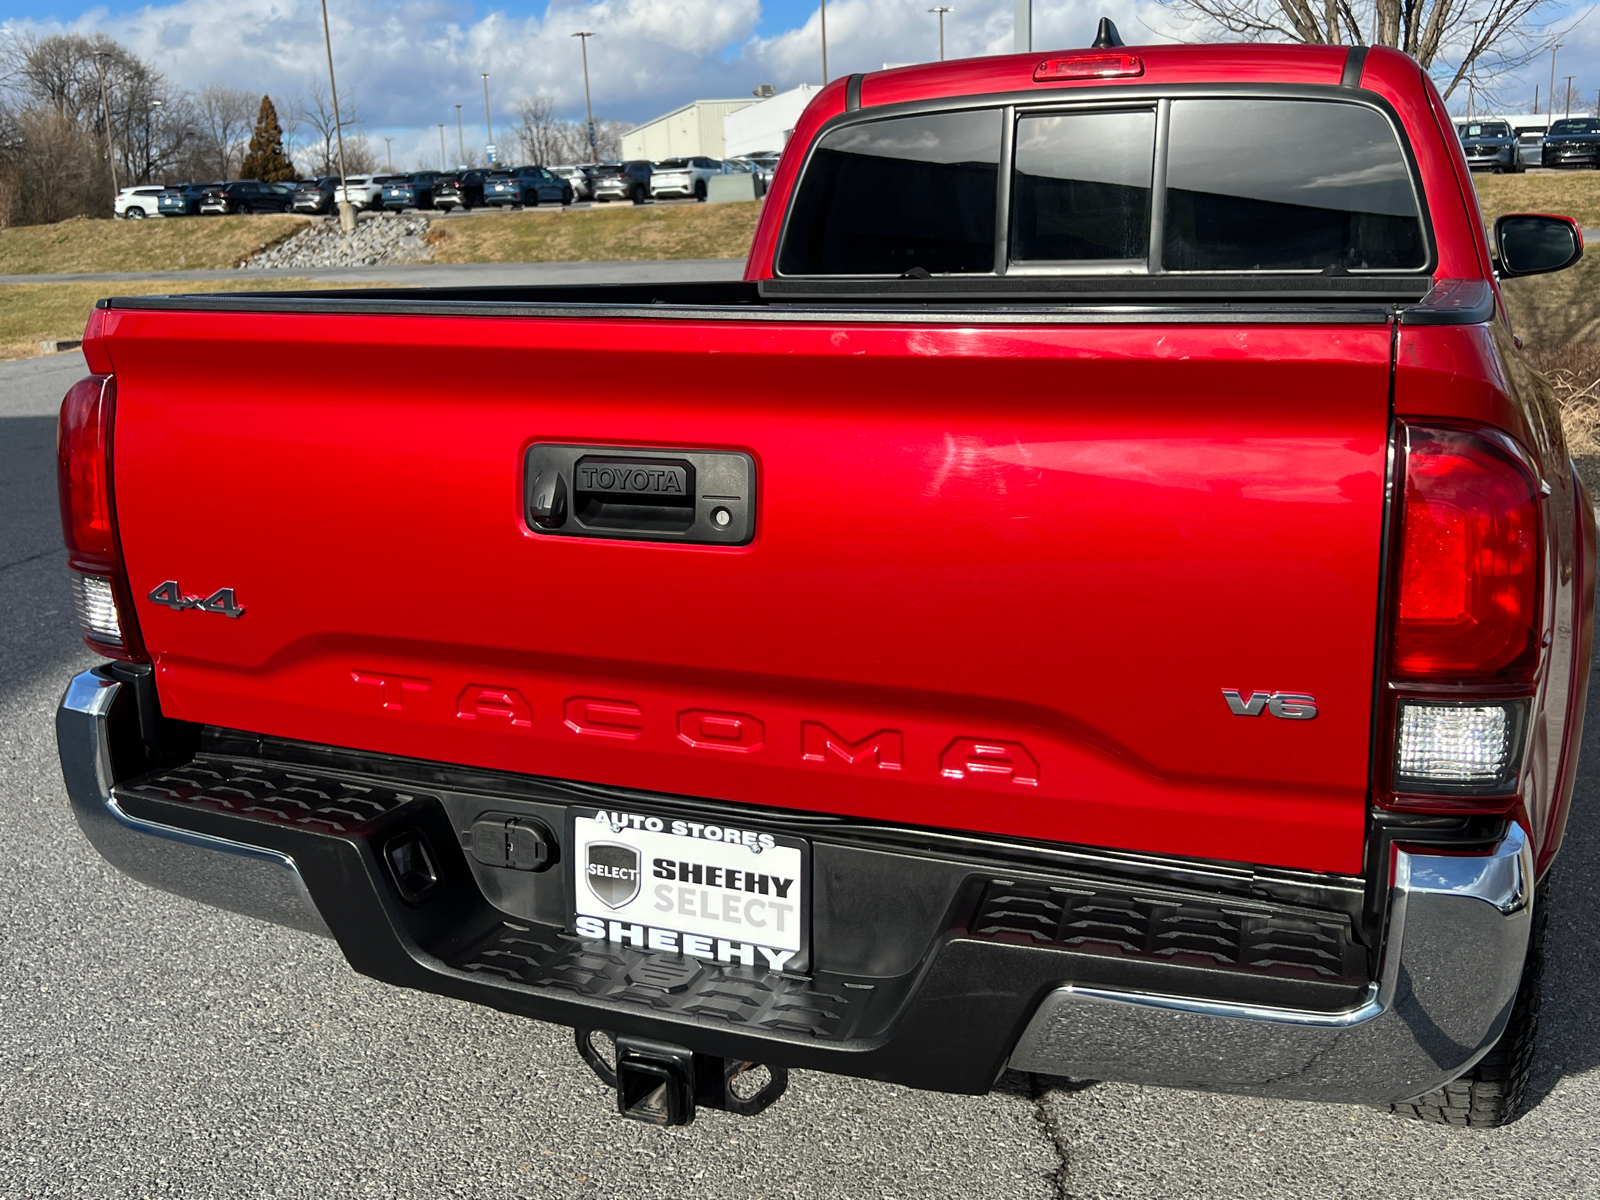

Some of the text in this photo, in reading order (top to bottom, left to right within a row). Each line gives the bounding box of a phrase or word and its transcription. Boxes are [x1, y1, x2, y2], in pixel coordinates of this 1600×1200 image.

[581, 467, 682, 493] TOYOTA
[1221, 688, 1318, 719] V6
[350, 671, 1040, 786] TACOMA
[594, 810, 776, 848] AUTO STORES
[588, 863, 638, 881] SELECT
[652, 857, 795, 899] SHEEHY
[653, 883, 794, 932] SELECT
[575, 916, 796, 971] SHEEHY
